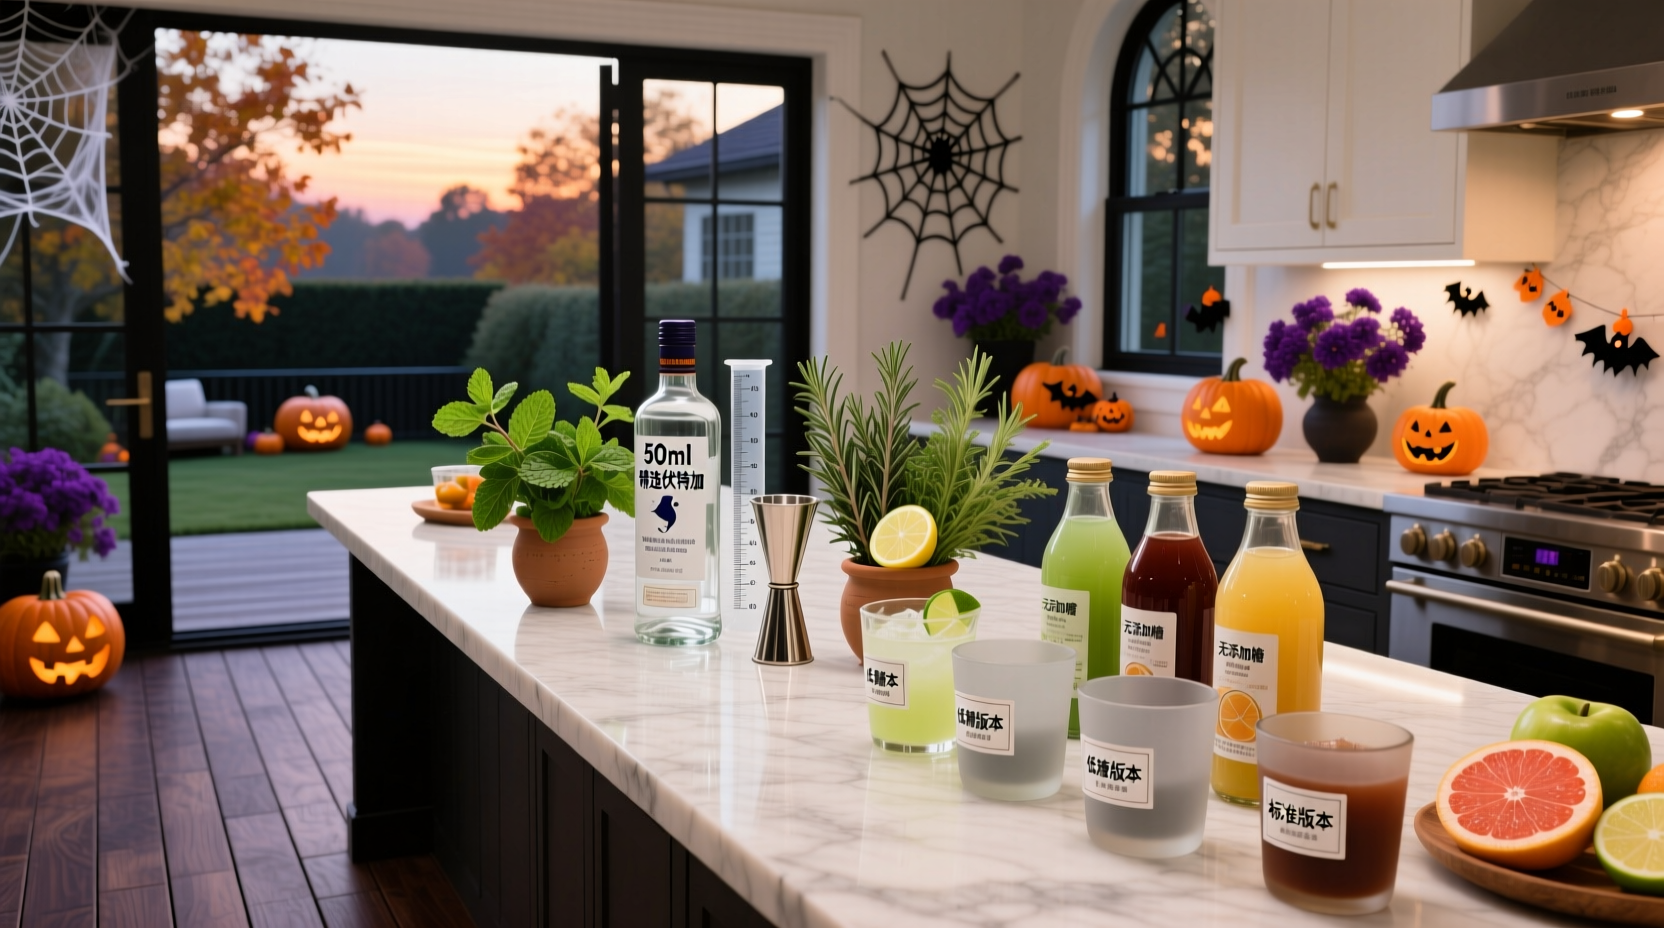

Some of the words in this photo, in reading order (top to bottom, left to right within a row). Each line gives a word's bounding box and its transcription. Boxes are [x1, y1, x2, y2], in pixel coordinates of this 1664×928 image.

[644, 443, 691, 466] 50ml
[1218, 640, 1265, 664] 无添加糖
[1268, 798, 1334, 830] 标准版本
